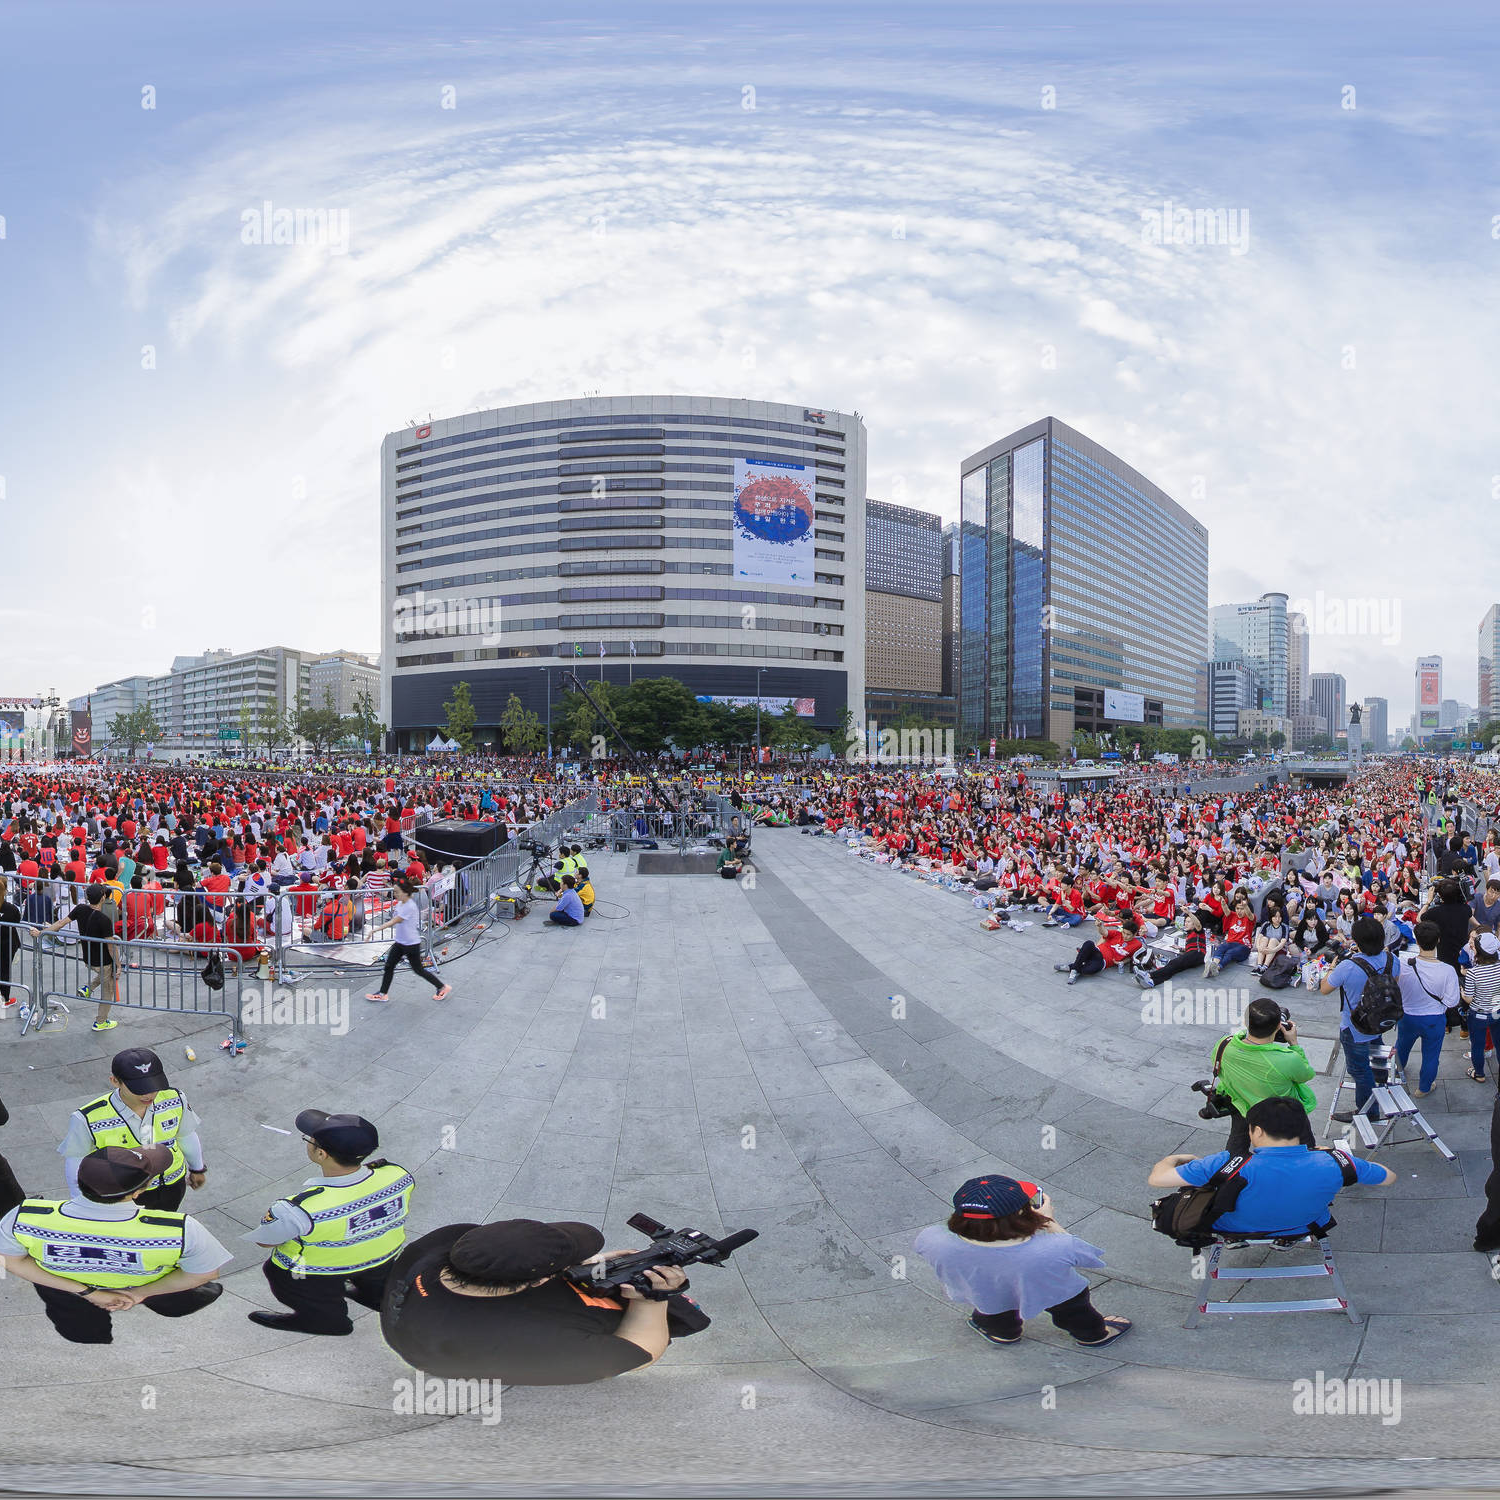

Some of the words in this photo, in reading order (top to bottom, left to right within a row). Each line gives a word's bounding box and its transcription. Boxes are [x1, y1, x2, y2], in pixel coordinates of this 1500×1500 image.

[41, 851, 52, 862] 10
[351, 1199, 400, 1226] 경찰
[351, 1213, 400, 1234] POLICE
[53, 1246, 131, 1262] 경찰
[53, 1257, 131, 1268] POLICE
